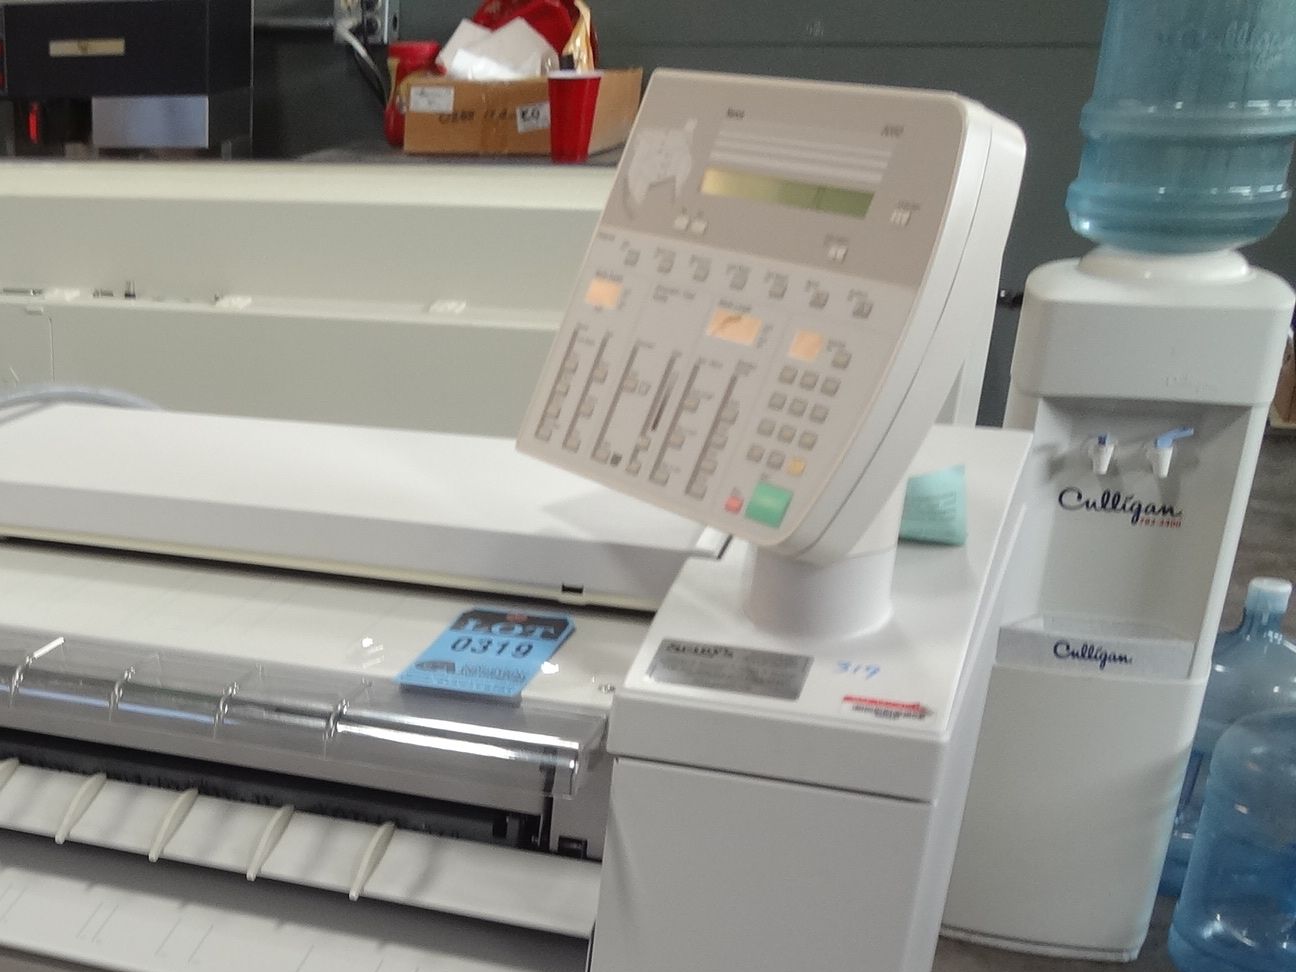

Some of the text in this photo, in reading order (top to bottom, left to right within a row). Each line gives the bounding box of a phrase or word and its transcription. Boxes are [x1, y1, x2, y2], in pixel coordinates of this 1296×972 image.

[1058, 487, 1182, 525] Culligan
[451, 637, 534, 658] 0319
[1053, 640, 1131, 669] Culligan
